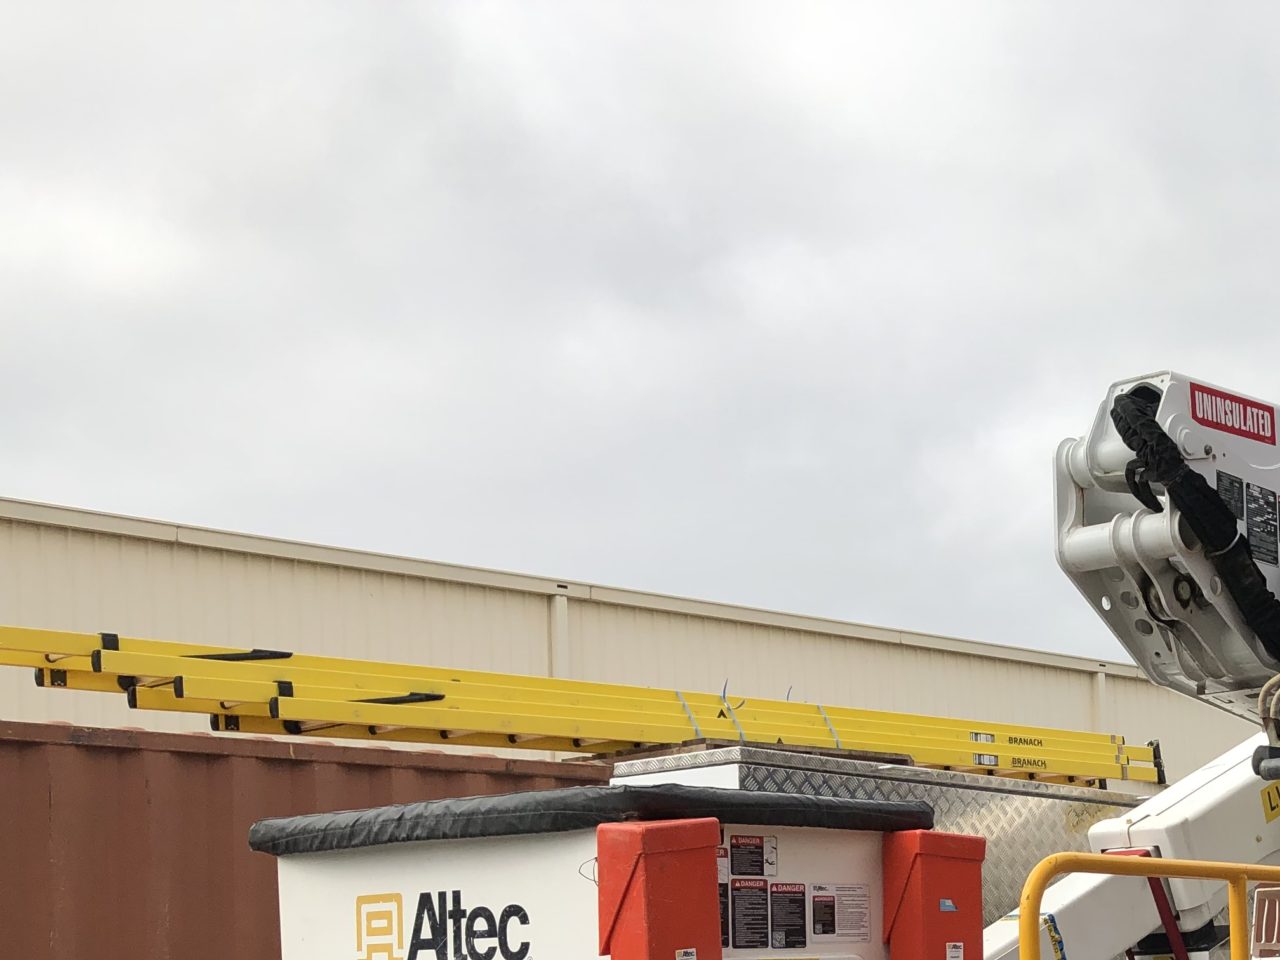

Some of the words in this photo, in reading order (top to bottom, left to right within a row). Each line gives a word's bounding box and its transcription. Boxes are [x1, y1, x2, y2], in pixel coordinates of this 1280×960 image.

[1194, 390, 1272, 437] UNINSULATED
[1008, 736, 1043, 747] BRANACH
[1012, 757, 1047, 769] BRANACH
